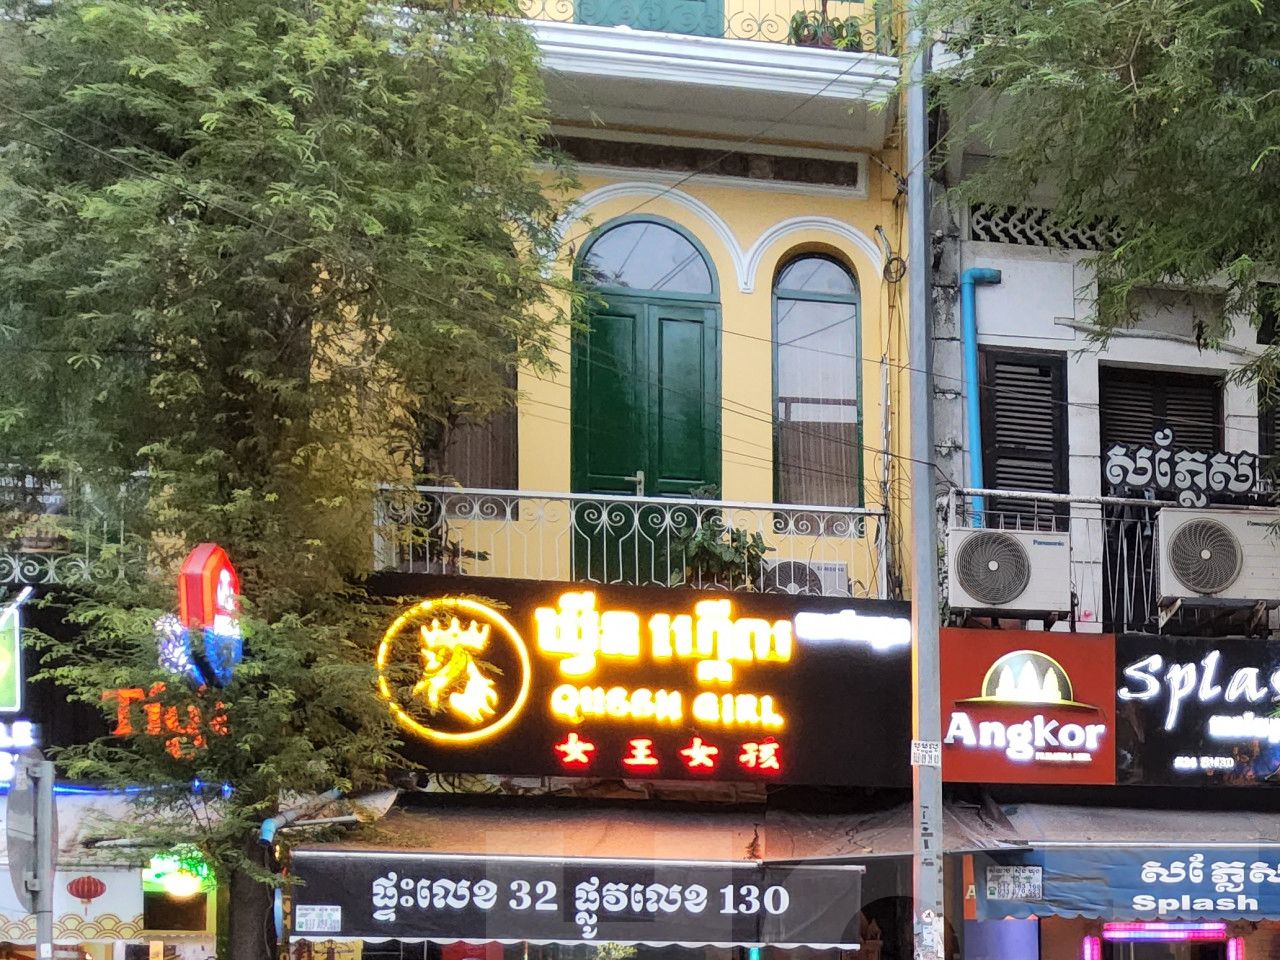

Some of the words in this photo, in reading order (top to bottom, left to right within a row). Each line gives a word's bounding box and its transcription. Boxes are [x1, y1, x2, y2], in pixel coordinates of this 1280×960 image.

[943, 711, 1107, 762] Angkor
[509, 879, 559, 912] 32
[719, 884, 791, 916] 130
[1131, 894, 1260, 915] Splash
